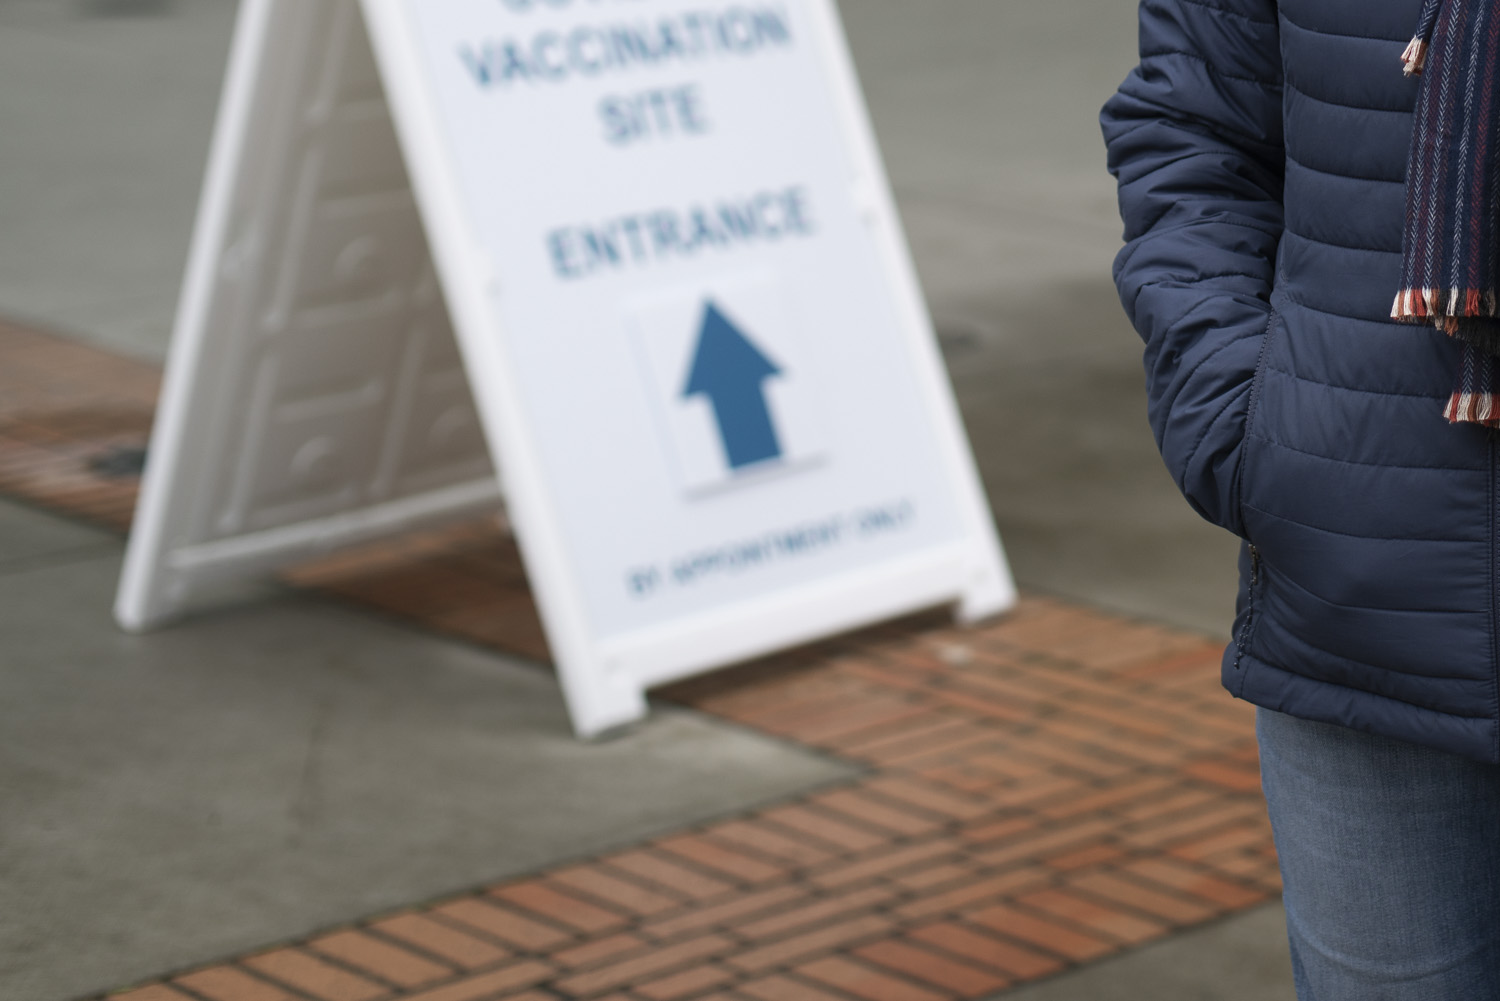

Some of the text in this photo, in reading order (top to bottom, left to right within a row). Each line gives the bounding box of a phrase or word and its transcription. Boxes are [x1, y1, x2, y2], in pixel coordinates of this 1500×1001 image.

[459, 6, 792, 89] VACCINATION
[599, 84, 707, 145] SITE
[547, 188, 815, 279] ENTRANCE
